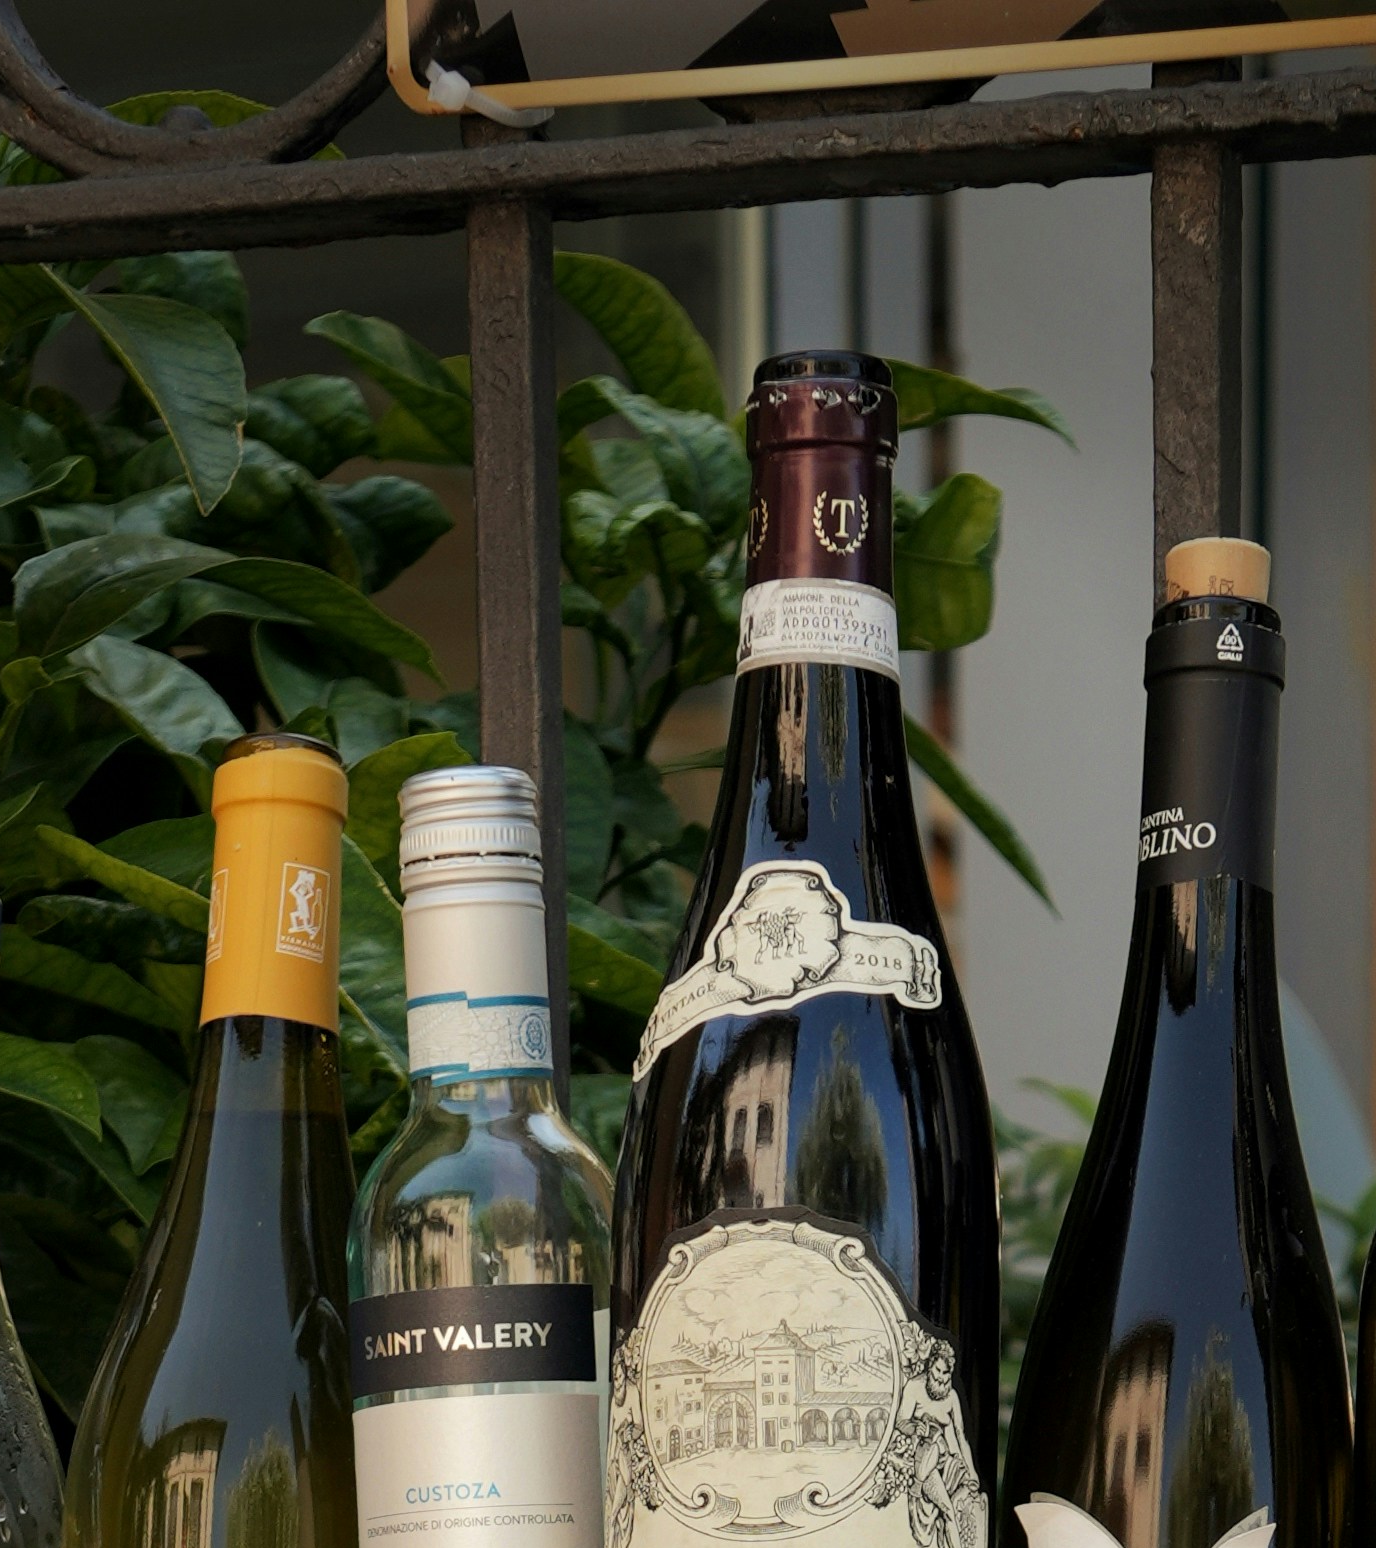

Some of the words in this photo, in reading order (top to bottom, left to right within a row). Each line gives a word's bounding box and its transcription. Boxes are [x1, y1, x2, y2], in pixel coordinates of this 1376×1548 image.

[831, 498, 855, 538] T
[854, 951, 903, 971] 2018
[660, 978, 718, 1024] VINTAGE
[364, 1327, 427, 1362] SAINT
[432, 1321, 552, 1352] VALERY
[404, 1480, 502, 1506] CUSTOZA
[368, 1523, 430, 1540] DENOMINAZIONE
[444, 1516, 491, 1529] ORIGINE
[493, 1513, 575, 1526] CONTROLLATA
